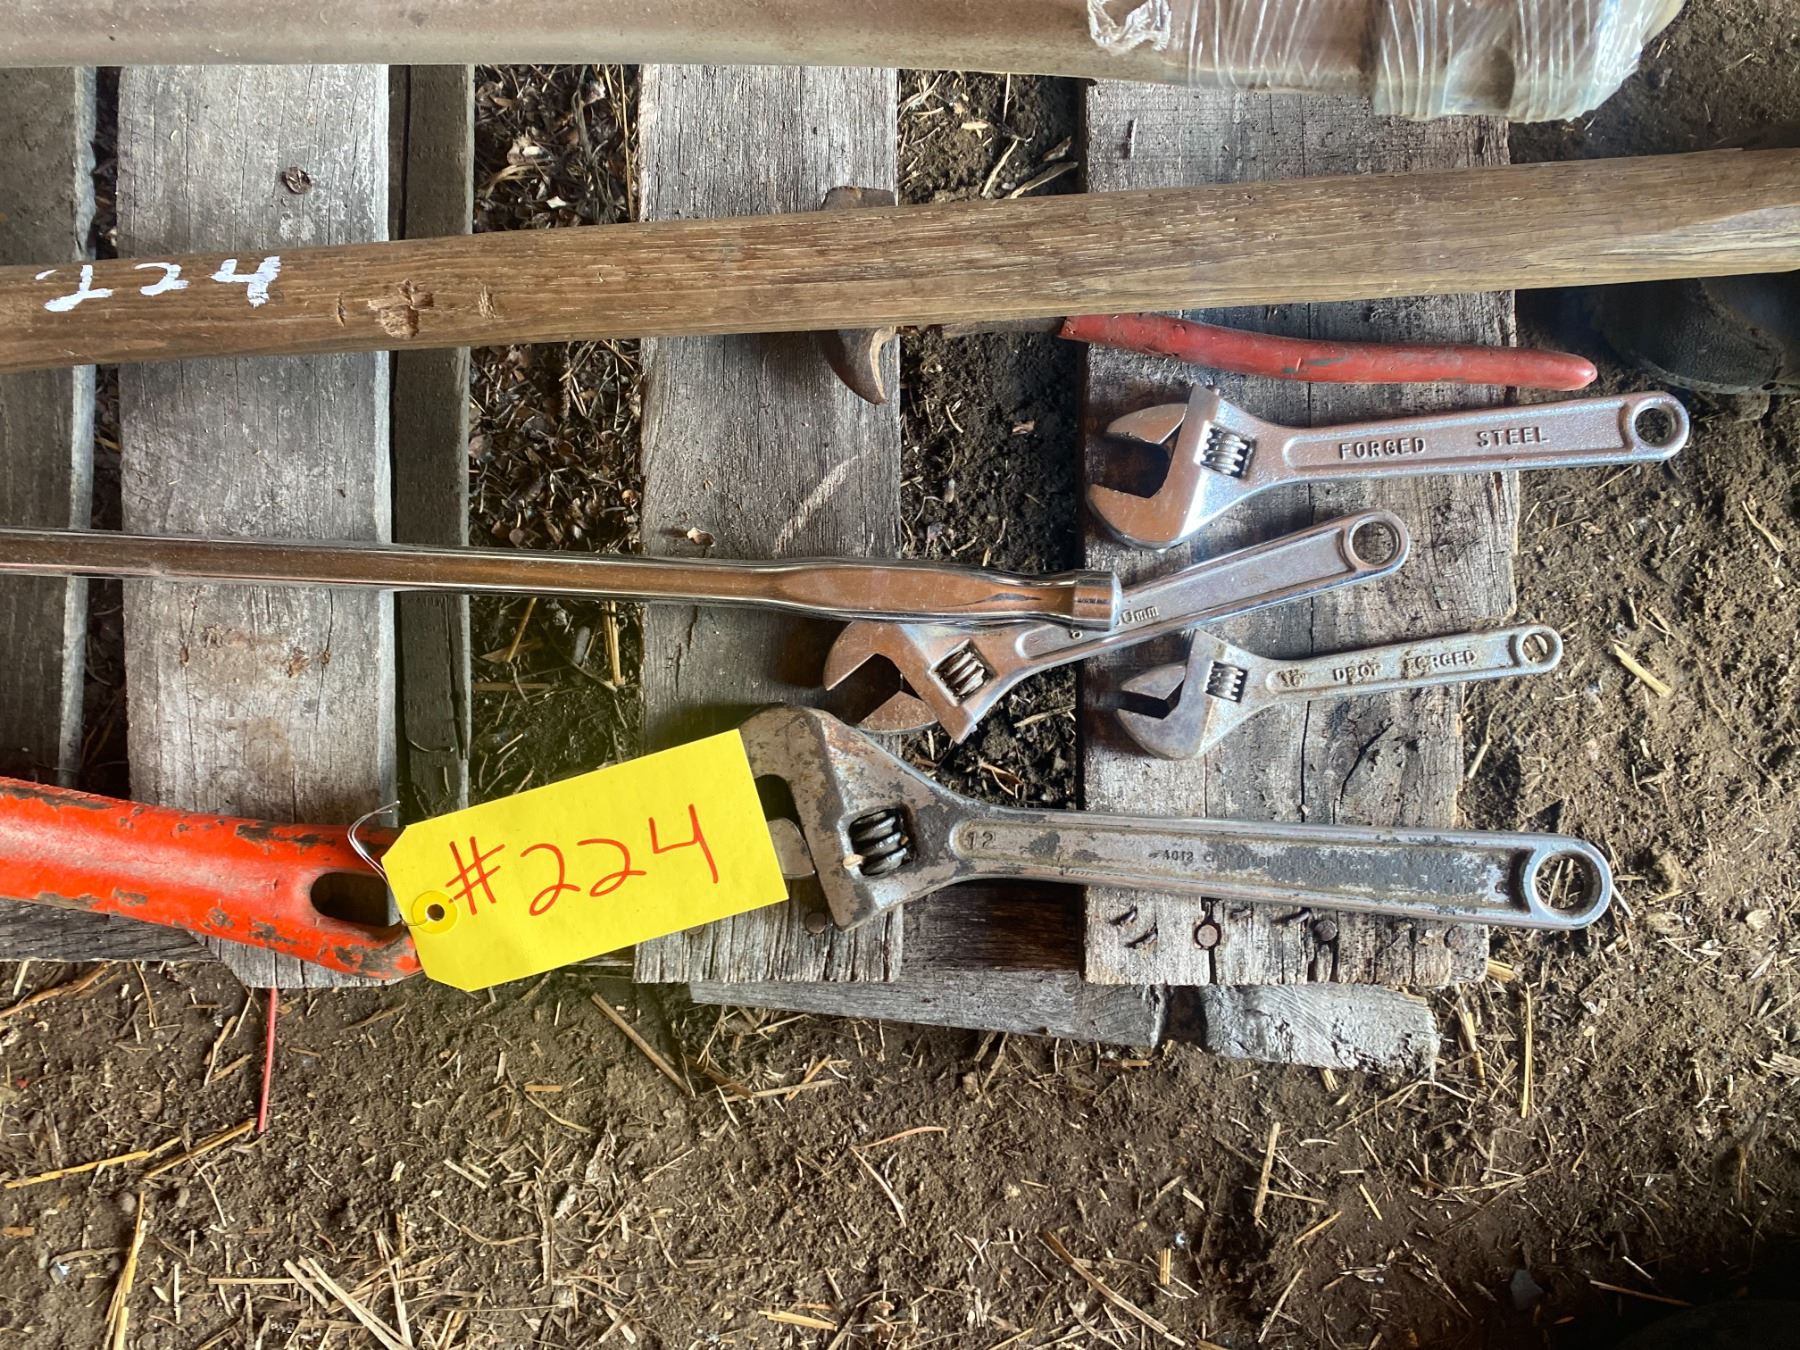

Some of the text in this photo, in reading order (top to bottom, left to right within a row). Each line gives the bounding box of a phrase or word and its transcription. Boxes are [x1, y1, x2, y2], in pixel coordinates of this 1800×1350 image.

[35, 256, 281, 312] 224
[1339, 426, 1551, 460] FORGED STEEL
[1115, 606, 1160, 626] 0mm
[1402, 650, 1478, 677] FORGED
[445, 804, 719, 916] #224
